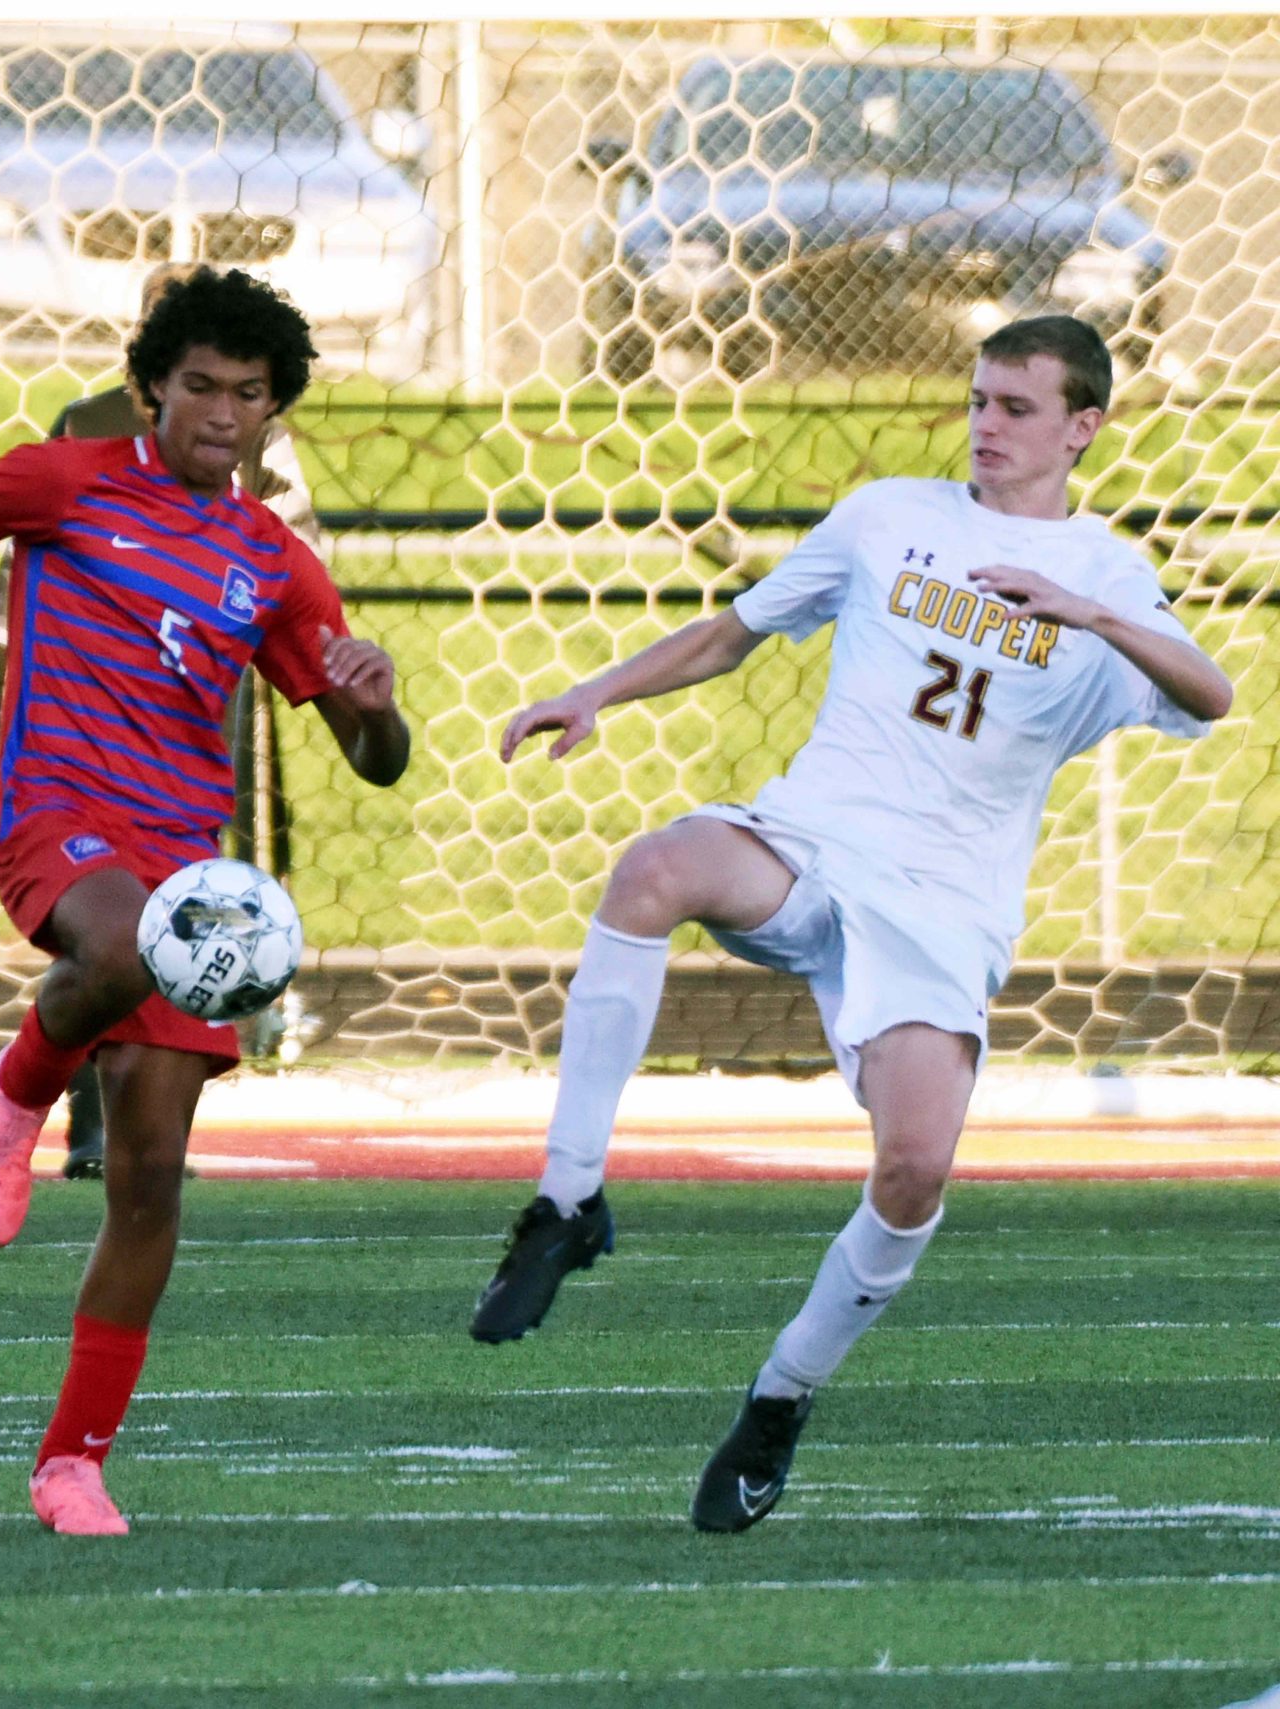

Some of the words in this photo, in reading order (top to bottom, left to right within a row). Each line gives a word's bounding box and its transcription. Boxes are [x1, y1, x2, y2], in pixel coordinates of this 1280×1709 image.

[157, 607, 193, 676] 5
[888, 570, 1060, 670] COOPER
[908, 649, 993, 742] 21
[186, 947, 236, 1014] SELEC
